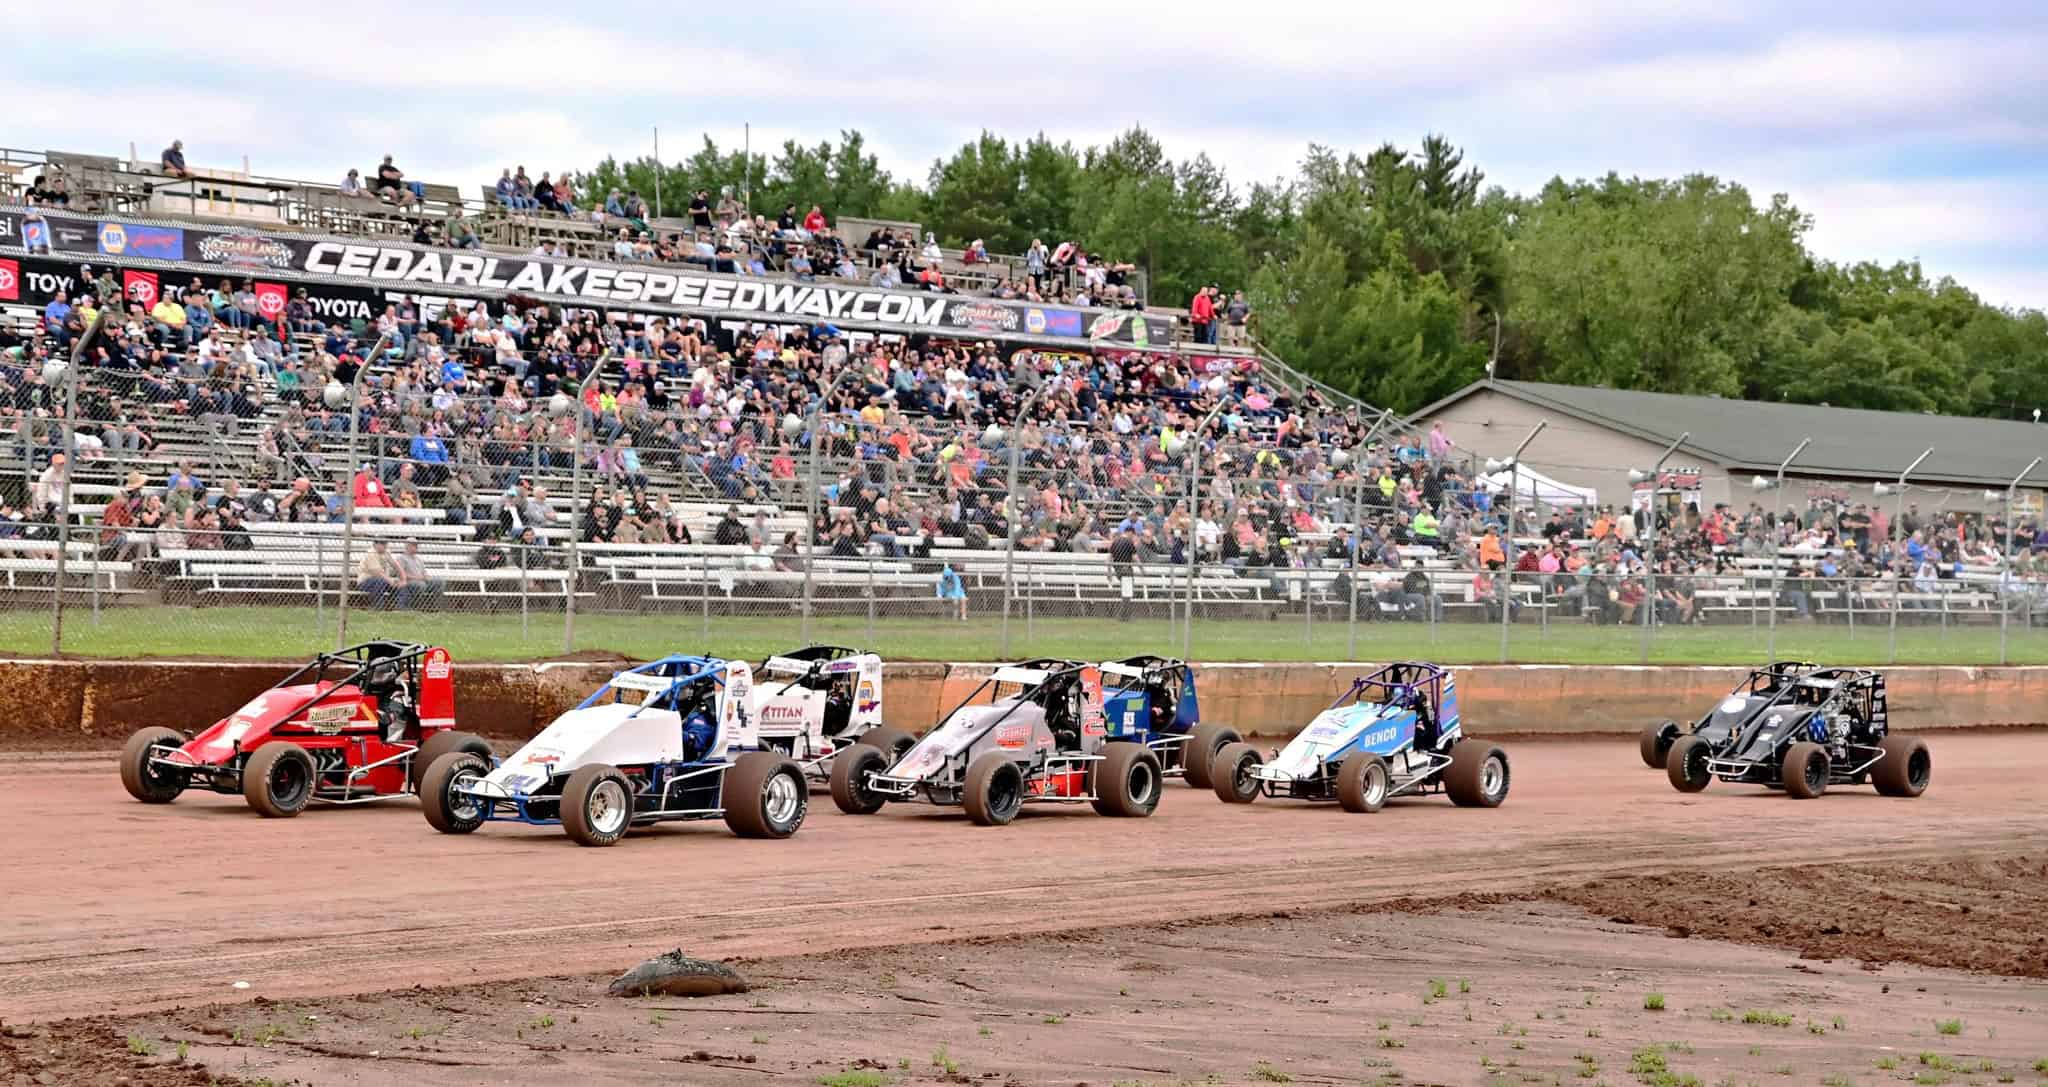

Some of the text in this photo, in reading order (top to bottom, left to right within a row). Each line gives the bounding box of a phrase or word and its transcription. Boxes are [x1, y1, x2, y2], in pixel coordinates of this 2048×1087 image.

[26, 272, 73, 293] TOY
[303, 242, 947, 326] CEDARLAKESPEEDWAY.COM
[308, 296, 372, 318] OYOTA
[769, 707, 803, 718] TITAN
[1364, 727, 1397, 747] BENCO
